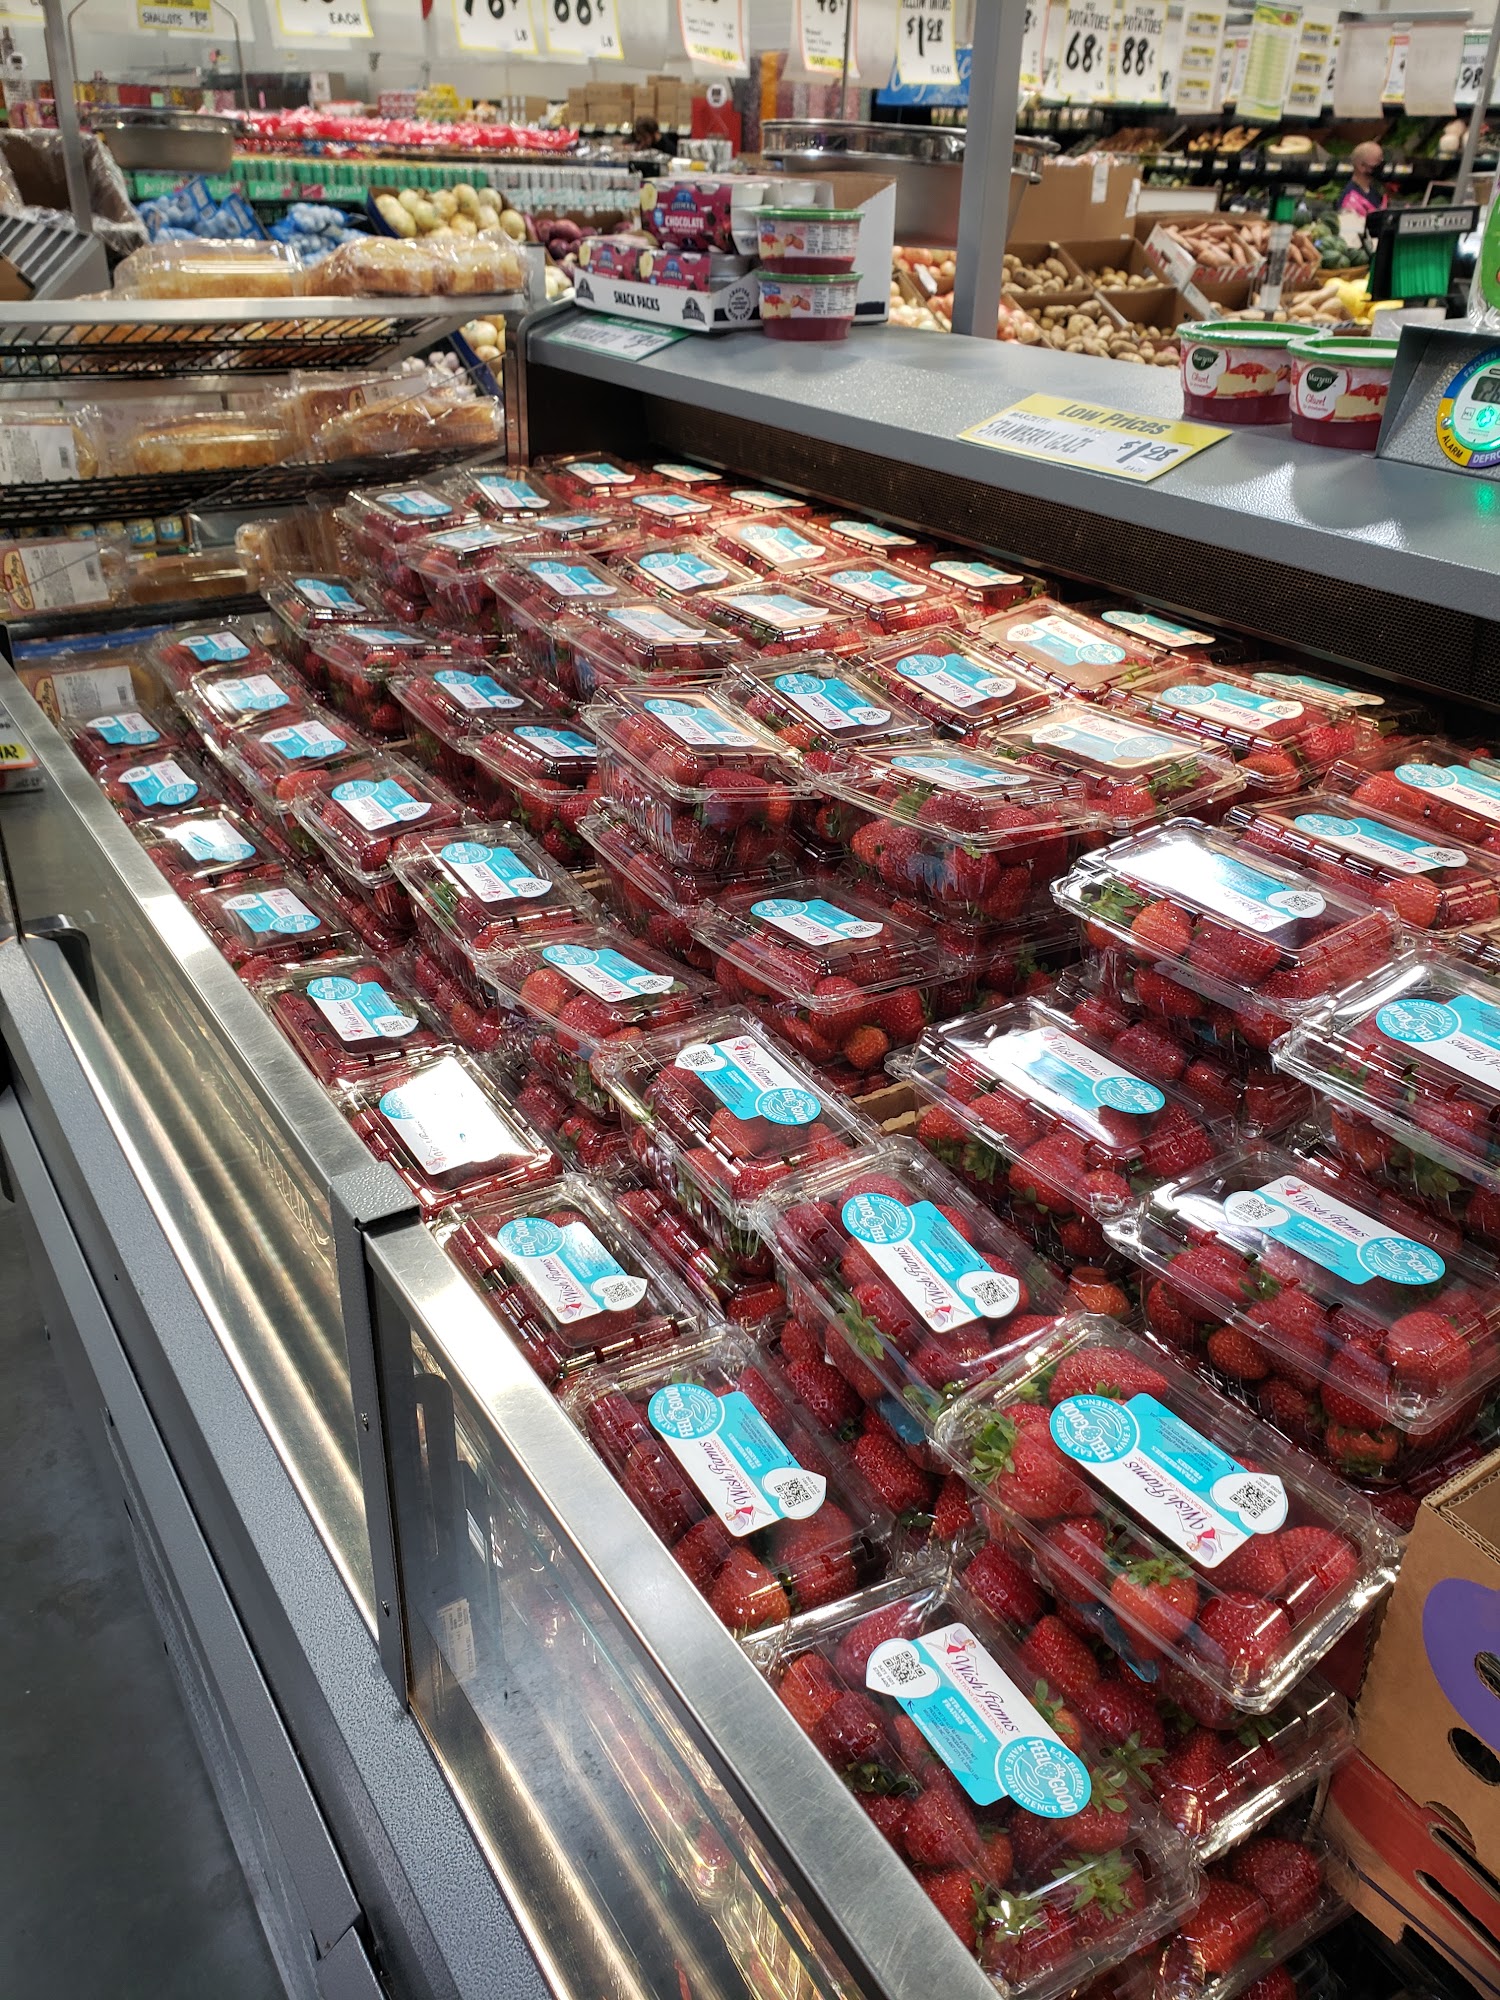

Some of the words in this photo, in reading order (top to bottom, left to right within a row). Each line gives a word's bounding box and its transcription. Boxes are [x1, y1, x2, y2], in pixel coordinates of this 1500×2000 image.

[1067, 10, 1111, 31] POTATOES
[1123, 15, 1163, 34] POTATOES
[664, 215, 704, 229] CHOCOLATE
[614, 291, 636, 308] SNACK
[637, 293, 660, 311] PACKS
[1463, 351, 1498, 378] FROZEN
[1057, 404, 1105, 423] Low
[1099, 413, 1171, 435] Prices
[979, 418, 1052, 448] STRAWBERRY
[1043, 434, 1094, 454] GLAZE
[1442, 435, 1464, 459] ALARM
[855, 1196, 875, 1217] GOOD
[1293, 1195, 1331, 1215] Wish
[1323, 1214, 1370, 1237] Farms
[869, 1225, 889, 1242] FEEL
[893, 1246, 920, 1277] Farms
[1379, 1238, 1404, 1254] FEEL
[1407, 1260, 1439, 1279] GOOD
[916, 1277, 944, 1304] Wish
[664, 1386, 684, 1409] GOOD
[677, 1418, 695, 1437] FEEL
[1060, 1402, 1089, 1429] GOOD
[699, 1441, 724, 1475] Farms
[1072, 1446, 1093, 1457] EAT
[1090, 1436, 1115, 1461] FEEL
[1150, 1445, 1199, 1484] STRAWBERRIES
[1176, 1458, 1204, 1480] FRAISES
[720, 1475, 748, 1505] Wish
[1123, 1460, 1167, 1499] Farms
[1167, 1498, 1204, 1531] Wish
[945, 1661, 975, 1697] GENERATIONS
[955, 1654, 985, 1697] Wish
[980, 1690, 1020, 1733] Farms
[941, 1699, 965, 1725] FRAISES
[947, 1696, 988, 1743] STRAWBERRIES
[1005, 1744, 1026, 1765] MAKE
[1027, 1739, 1052, 1766] FEEL
[1048, 1778, 1079, 1813] GOOD
[1049, 1746, 1069, 1761] EAT
[1068, 1761, 1085, 1799] BERRIES
